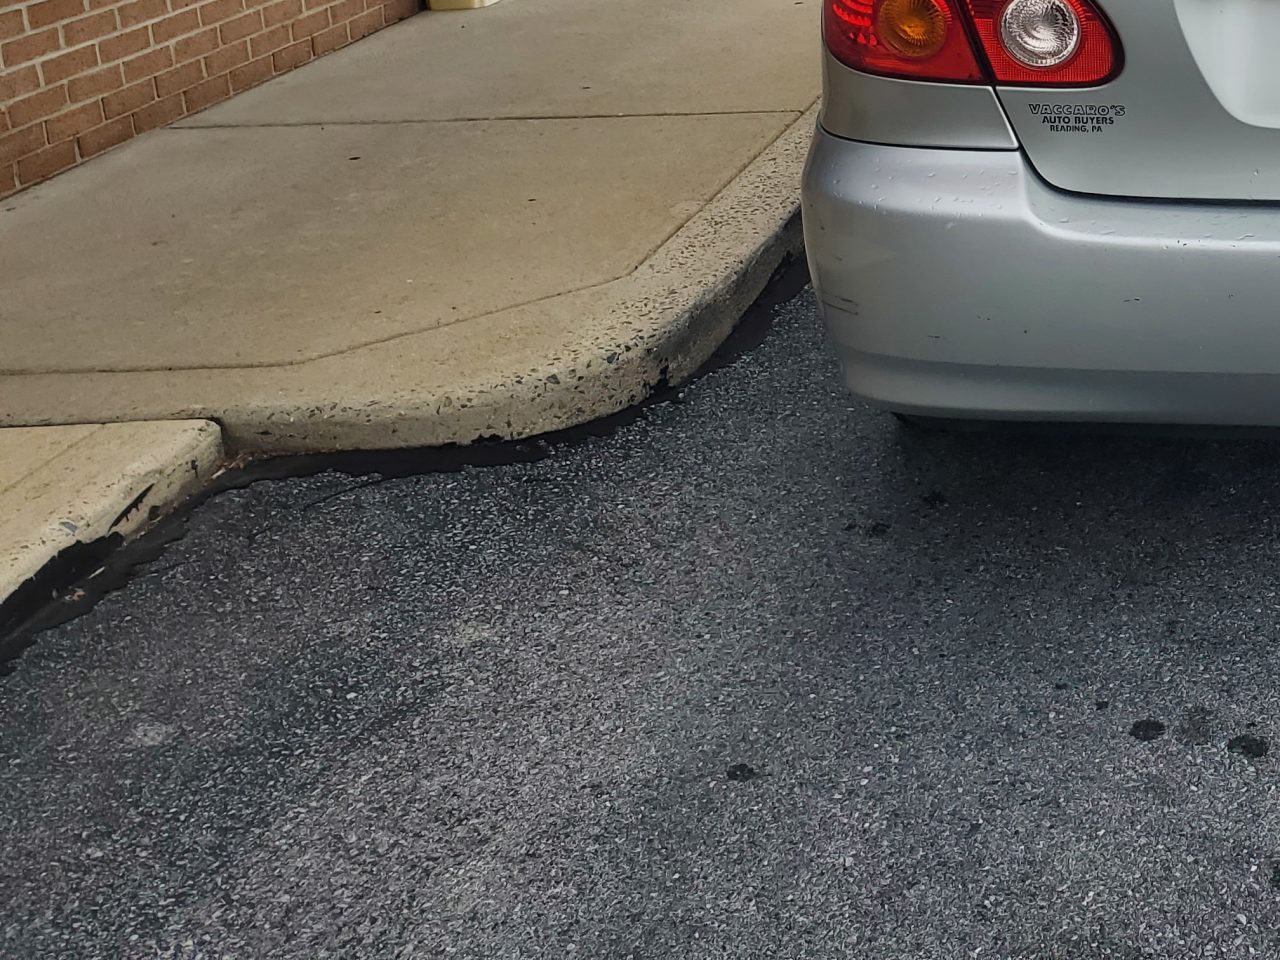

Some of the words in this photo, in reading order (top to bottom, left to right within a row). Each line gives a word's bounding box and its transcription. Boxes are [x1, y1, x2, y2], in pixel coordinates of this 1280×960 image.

[1028, 104, 1126, 116] VACCARO'S
[1041, 116, 1071, 125] AUTO
[1074, 116, 1114, 125] BUYERS
[1049, 125, 1089, 133] READING,
[1091, 125, 1103, 133] PA
